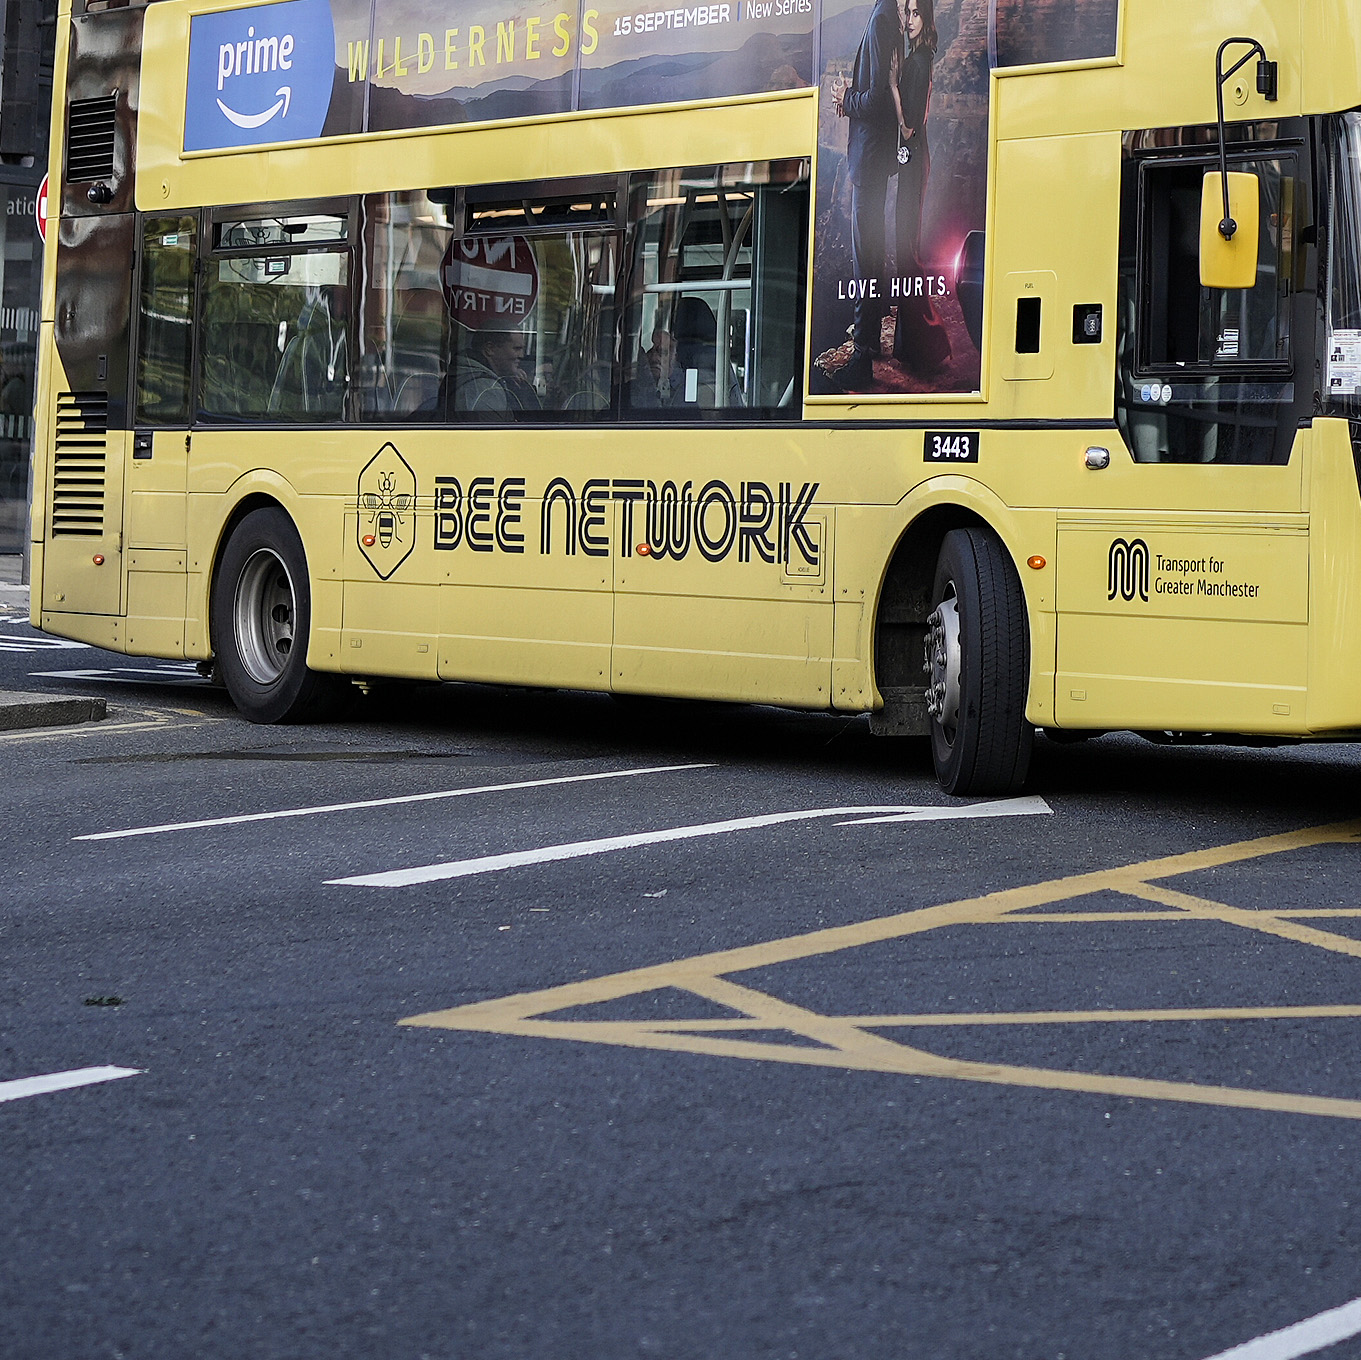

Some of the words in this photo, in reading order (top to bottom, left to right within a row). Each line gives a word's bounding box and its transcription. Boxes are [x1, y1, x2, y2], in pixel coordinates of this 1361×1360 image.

[614, 15, 632, 36] 15
[634, 3, 731, 33] SEPTEMBER
[746, 0, 773, 20] New
[347, 8, 600, 83] WILDERNESS
[217, 26, 295, 91] prime
[838, 278, 881, 300] LOVE.
[891, 275, 951, 297] HURTS.
[932, 436, 970, 458] 3443
[434, 476, 526, 553] BEE
[539, 477, 821, 565] NETWORK
[1156, 554, 1206, 577] Transport
[1209, 556, 1225, 574] for
[1155, 577, 1194, 595] Greater
[1197, 579, 1260, 598] Manchester
